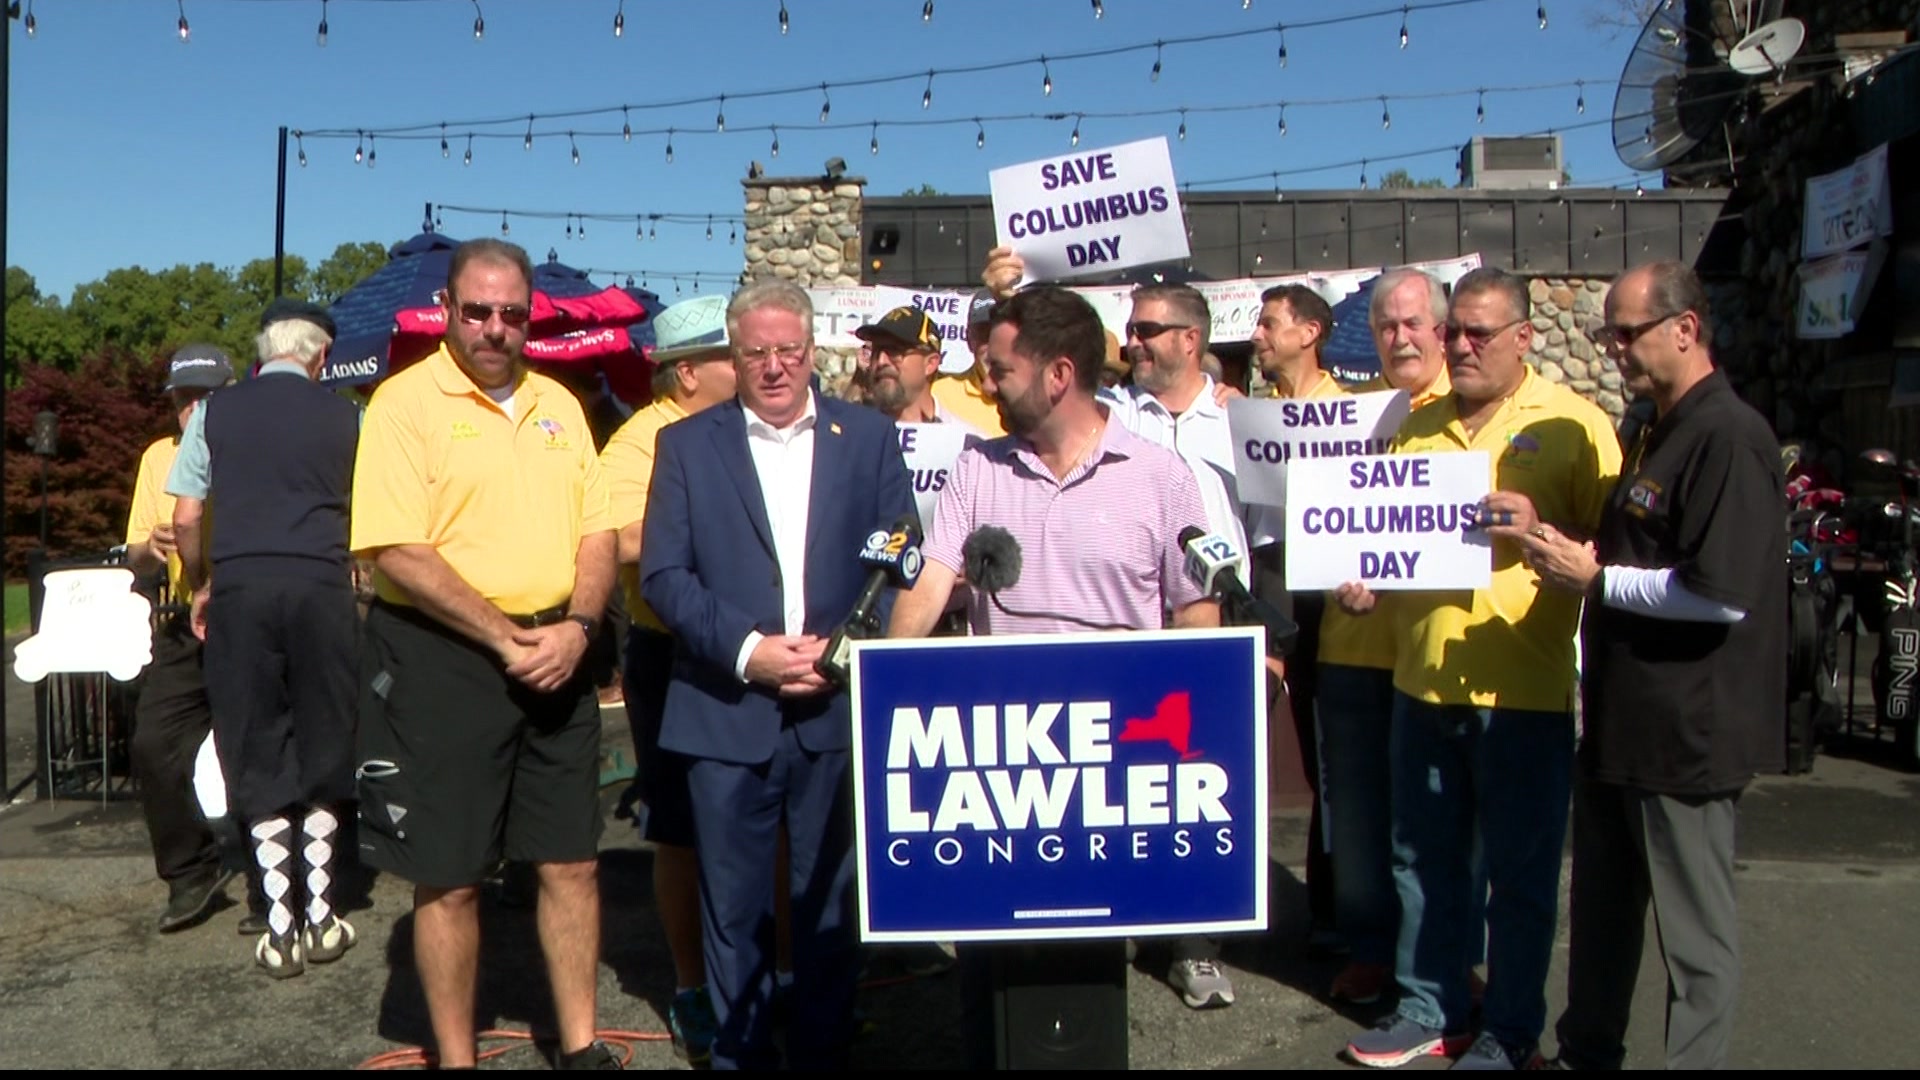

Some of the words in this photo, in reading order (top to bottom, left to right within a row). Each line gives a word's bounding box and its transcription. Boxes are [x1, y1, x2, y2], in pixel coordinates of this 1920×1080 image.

[1041, 153, 1117, 191] SAVE
[1008, 186, 1168, 239] COLUMBUS
[1066, 235, 1121, 268] DAY
[912, 294, 960, 315] SAVE
[331, 356, 379, 380] ADAMS
[1282, 400, 1358, 427] SAVE
[1350, 459, 1431, 488] SAVE
[1303, 503, 1477, 535] COLUMBUS
[859, 549, 898, 563] NEWS
[884, 532, 908, 554] 2
[1202, 541, 1237, 562] 12
[1360, 551, 1421, 579] DAY
[1886, 628, 1919, 720] PING
[886, 701, 1113, 769] MIKE
[886, 762, 1233, 833] LAWLER
[887, 828, 1234, 866] CONGRESS
